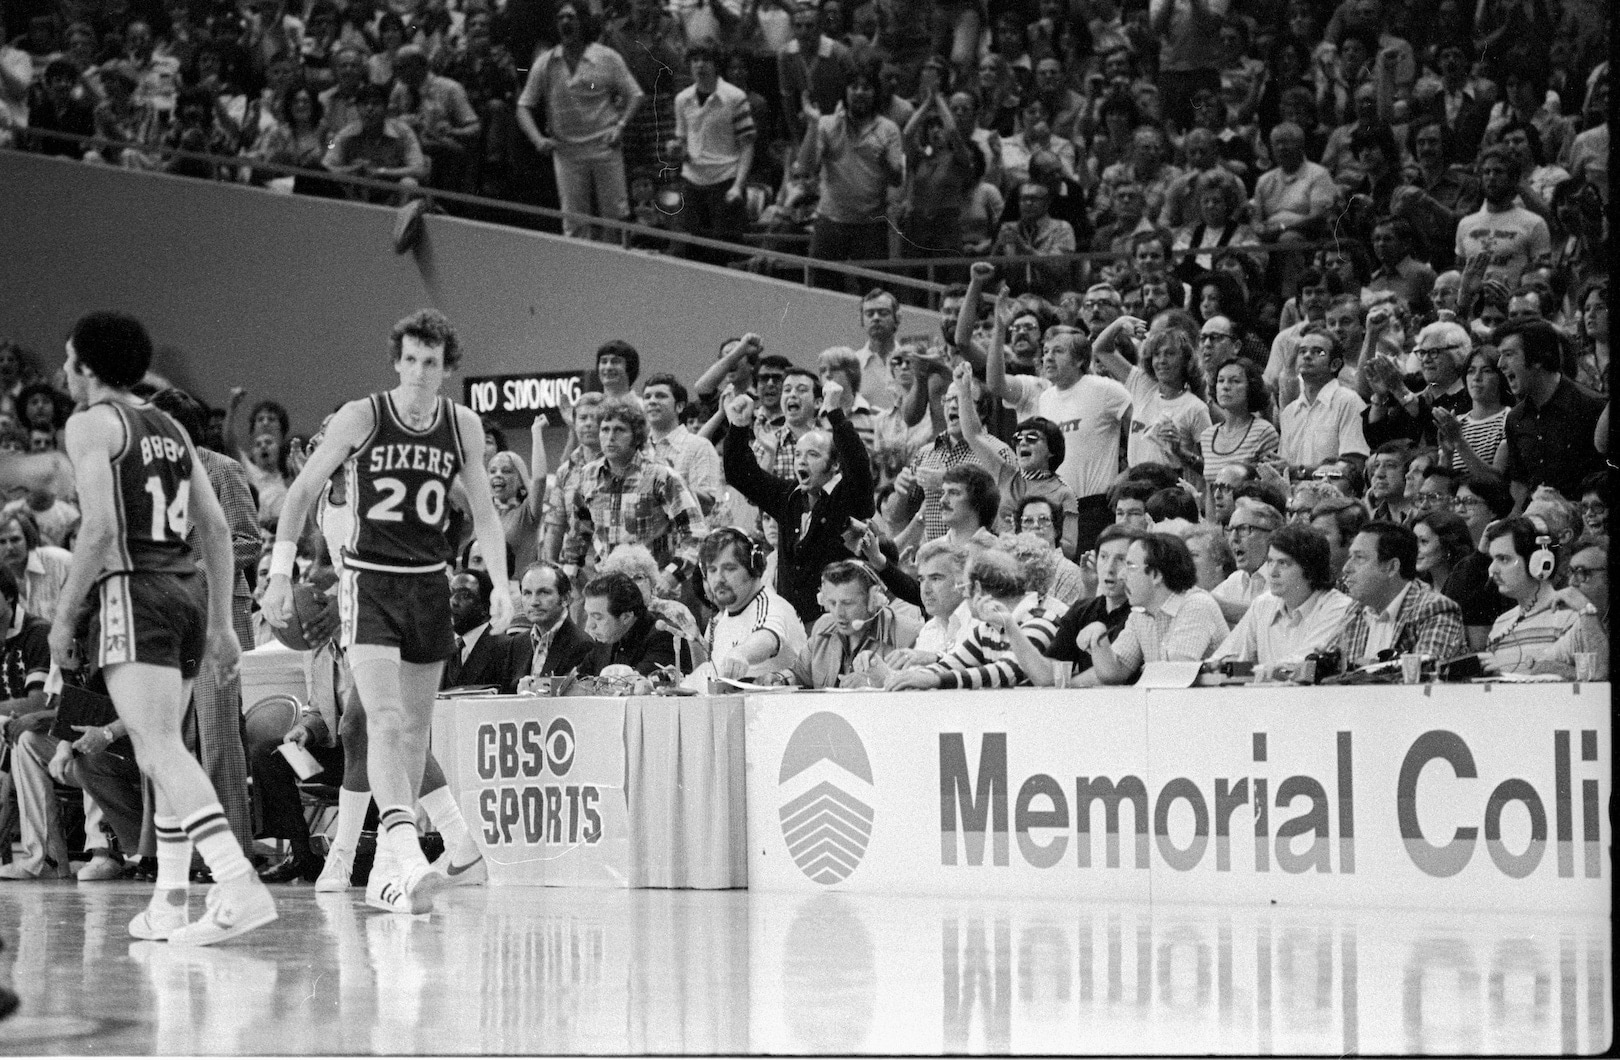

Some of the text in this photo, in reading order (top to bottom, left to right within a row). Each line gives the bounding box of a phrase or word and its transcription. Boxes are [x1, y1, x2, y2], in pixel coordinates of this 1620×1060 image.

[471, 376, 582, 413] NO SMOKING
[369, 443, 455, 479] SIXERS
[144, 475, 191, 541] 14
[366, 476, 446, 525] 20
[476, 720, 544, 781] CBS
[478, 784, 603, 846] SPORTS
[938, 728, 1602, 880] Memorial Coli
